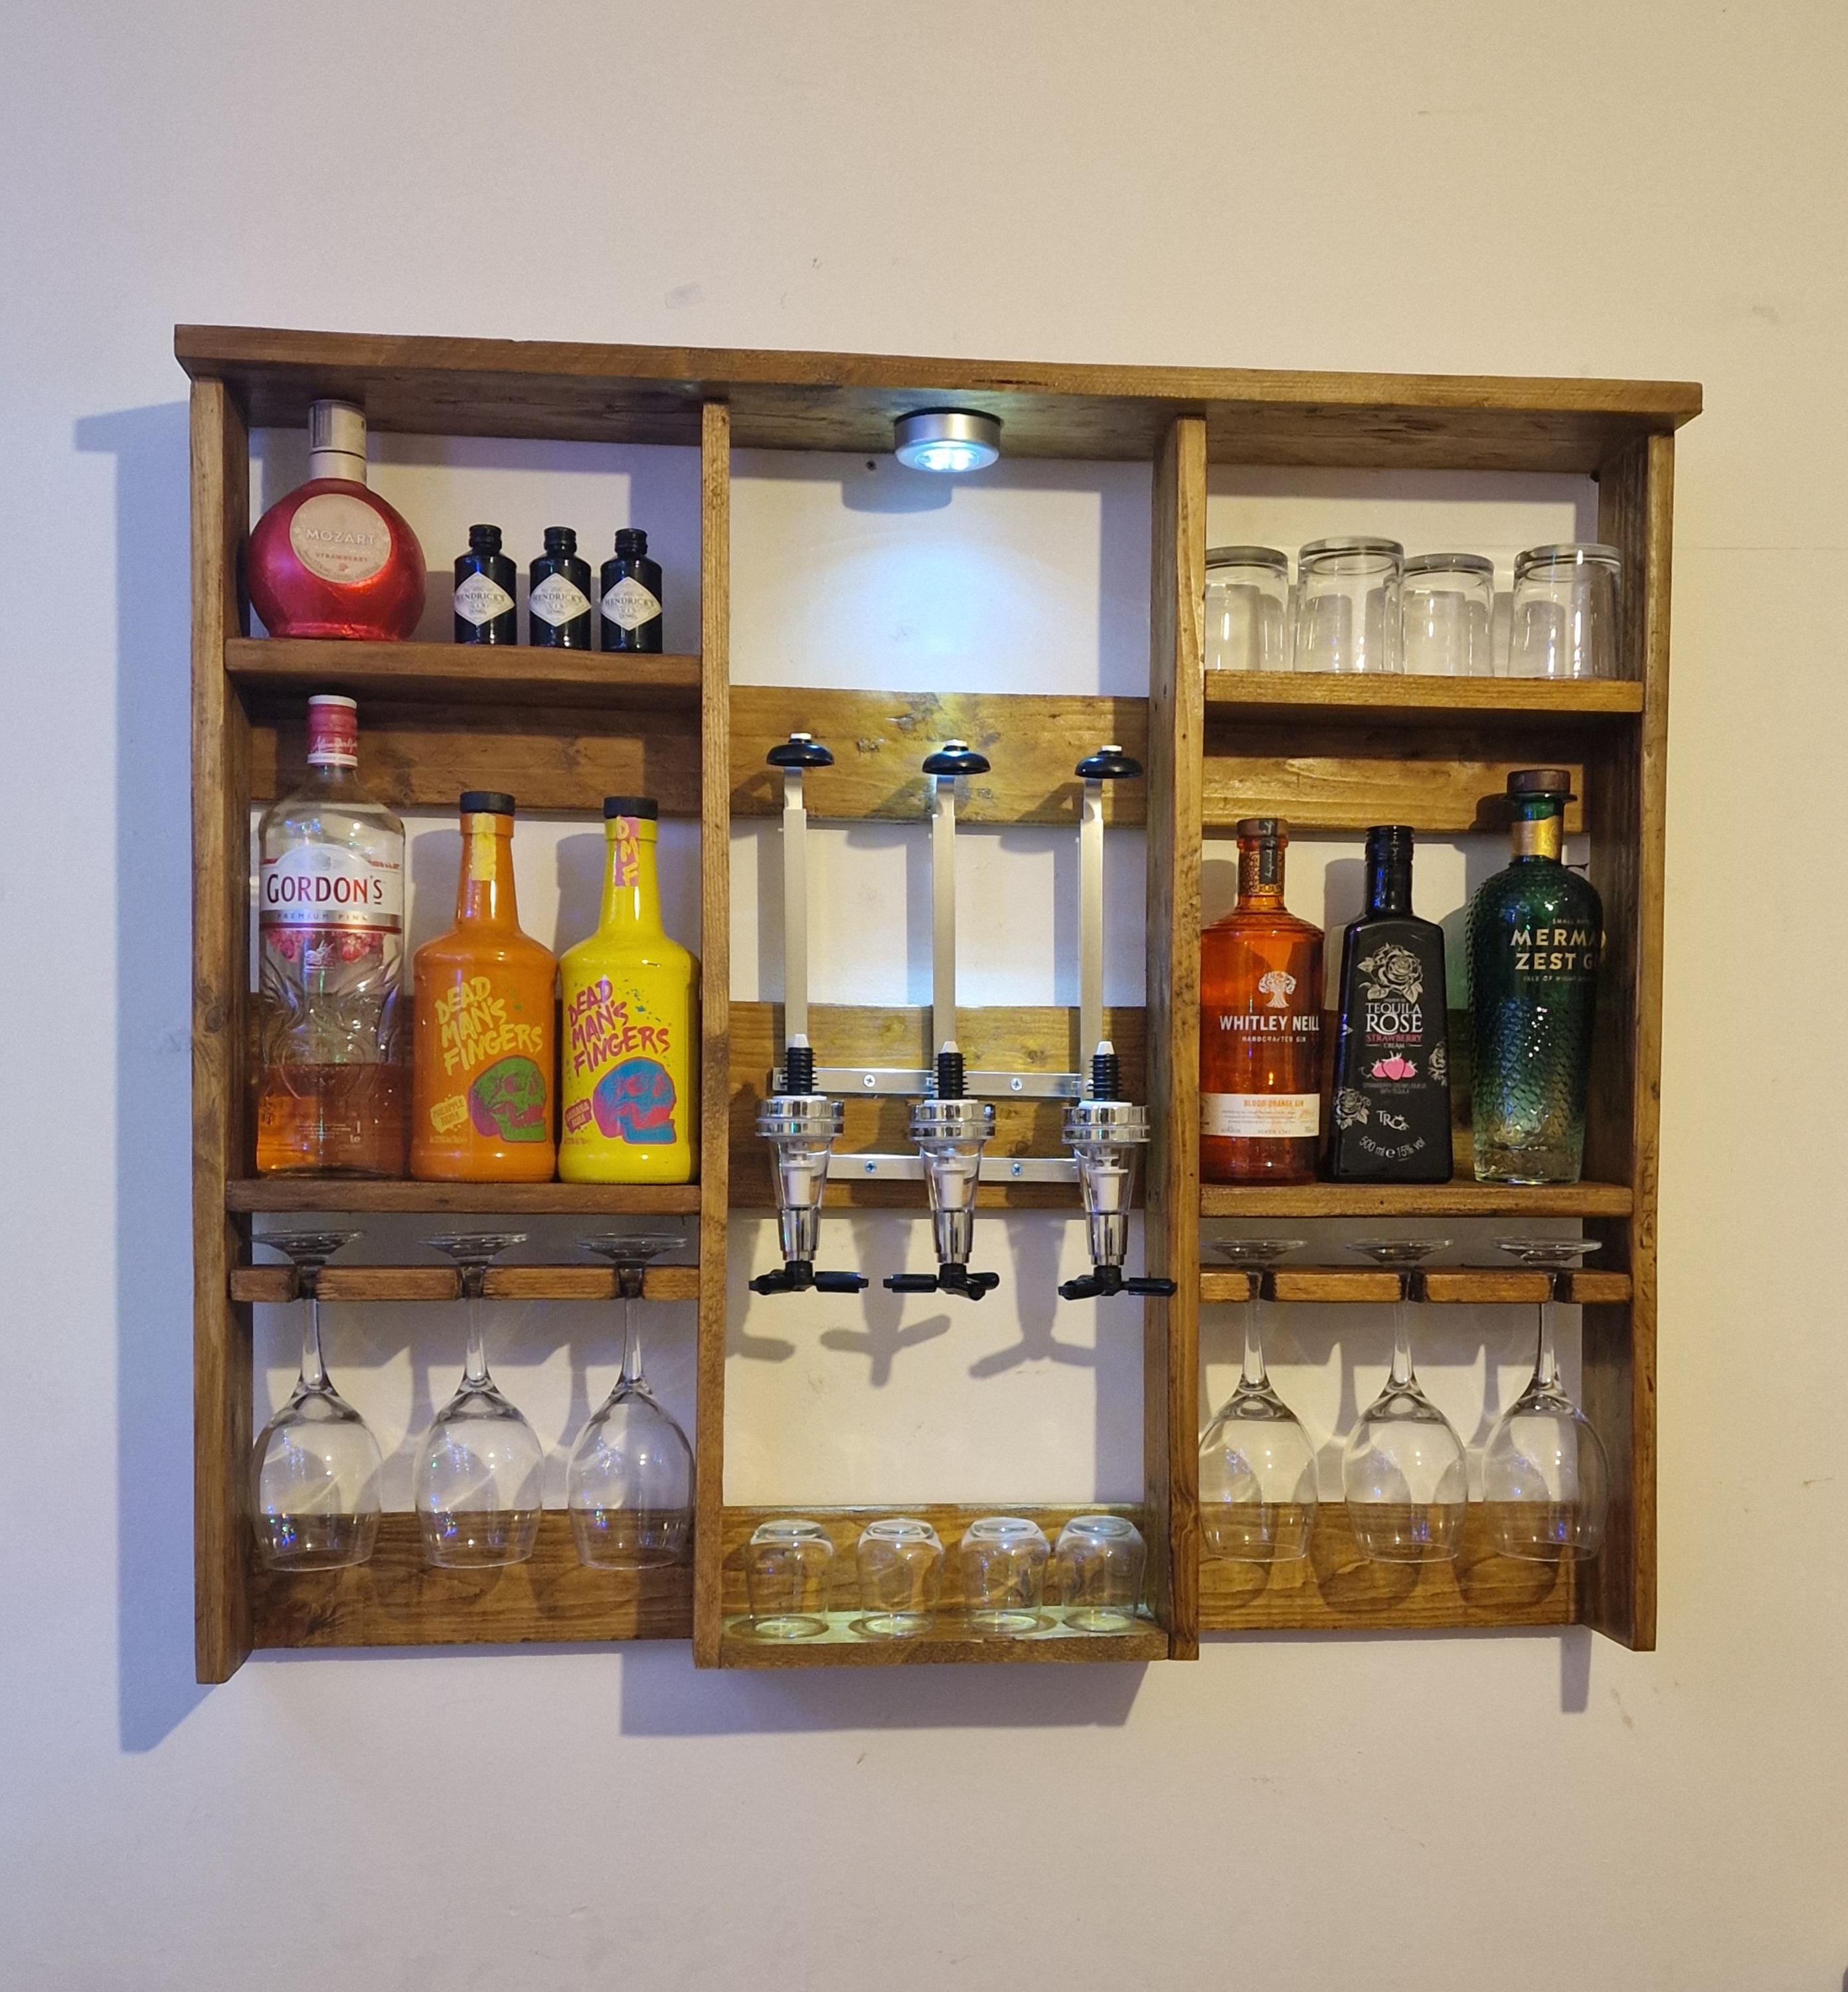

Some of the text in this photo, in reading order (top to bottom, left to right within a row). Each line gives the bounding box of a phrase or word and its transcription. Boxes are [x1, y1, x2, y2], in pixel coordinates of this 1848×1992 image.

[306, 529, 375, 545] MOZART
[267, 873, 383, 905] GORDON'S
[277, 912, 329, 920] PREMIUM
[1515, 952, 1576, 970] ZEST
[434, 976, 491, 1025] DEAD
[567, 979, 613, 1027] DEAD
[1365, 1003, 1422, 1014] TEQUILA
[442, 997, 507, 1048] MAN'S
[572, 999, 629, 1050] MAN'S
[1219, 1015, 1319, 1031] WHITLEY NEILL
[1365, 1013, 1424, 1036] ROSE
[1365, 1034, 1423, 1042] STRAWBERRY
[444, 1024, 543, 1076] FINGERS
[574, 1026, 670, 1078] FINGERS
[1359, 1135, 1376, 1152] 500
